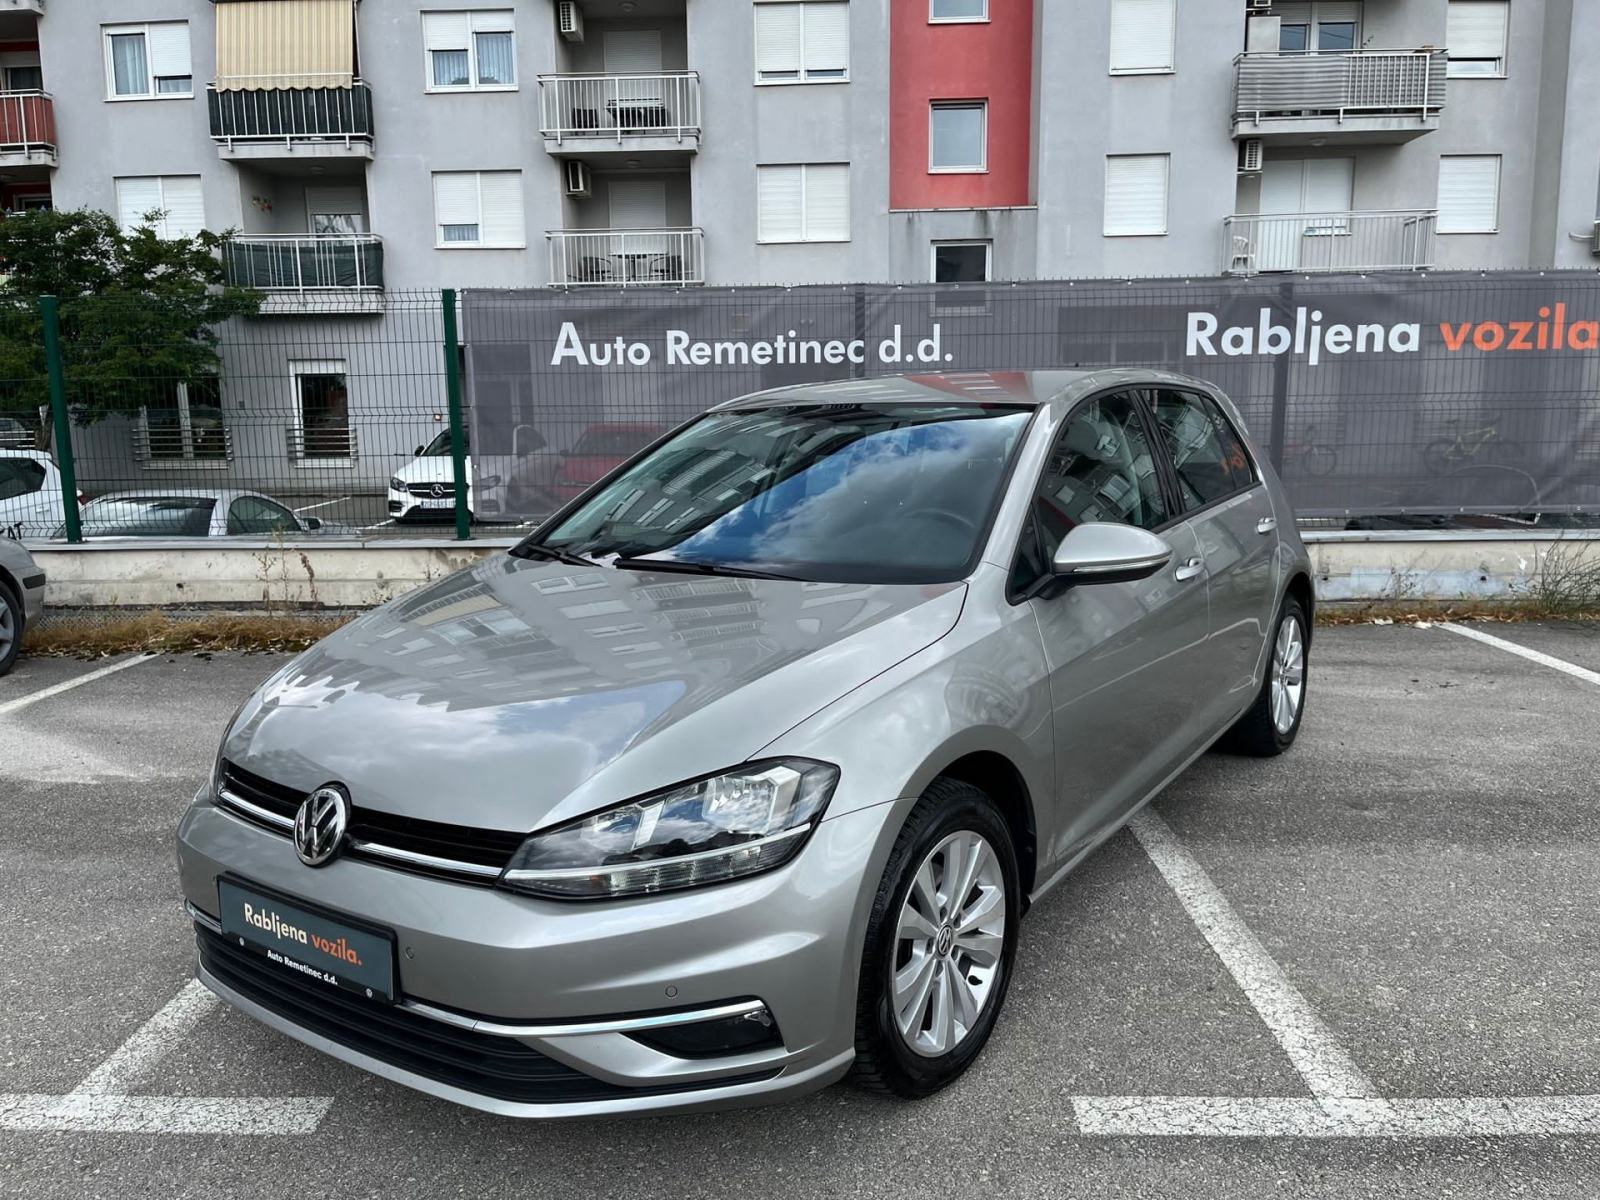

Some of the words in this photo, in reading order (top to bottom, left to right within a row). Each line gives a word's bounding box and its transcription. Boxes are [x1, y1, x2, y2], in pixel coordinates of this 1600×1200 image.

[551, 321, 651, 366] Auto
[665, 329, 865, 366] Remetinec
[878, 323, 954, 363] d.d.
[1186, 306, 1421, 366] Rabljena
[1439, 302, 1599, 351] vozila
[244, 902, 308, 945] Rabljena
[311, 934, 363, 966] vozila.
[267, 949, 284, 963] Auto
[284, 956, 322, 980] Remetinec
[323, 973, 338, 985] d.d.
